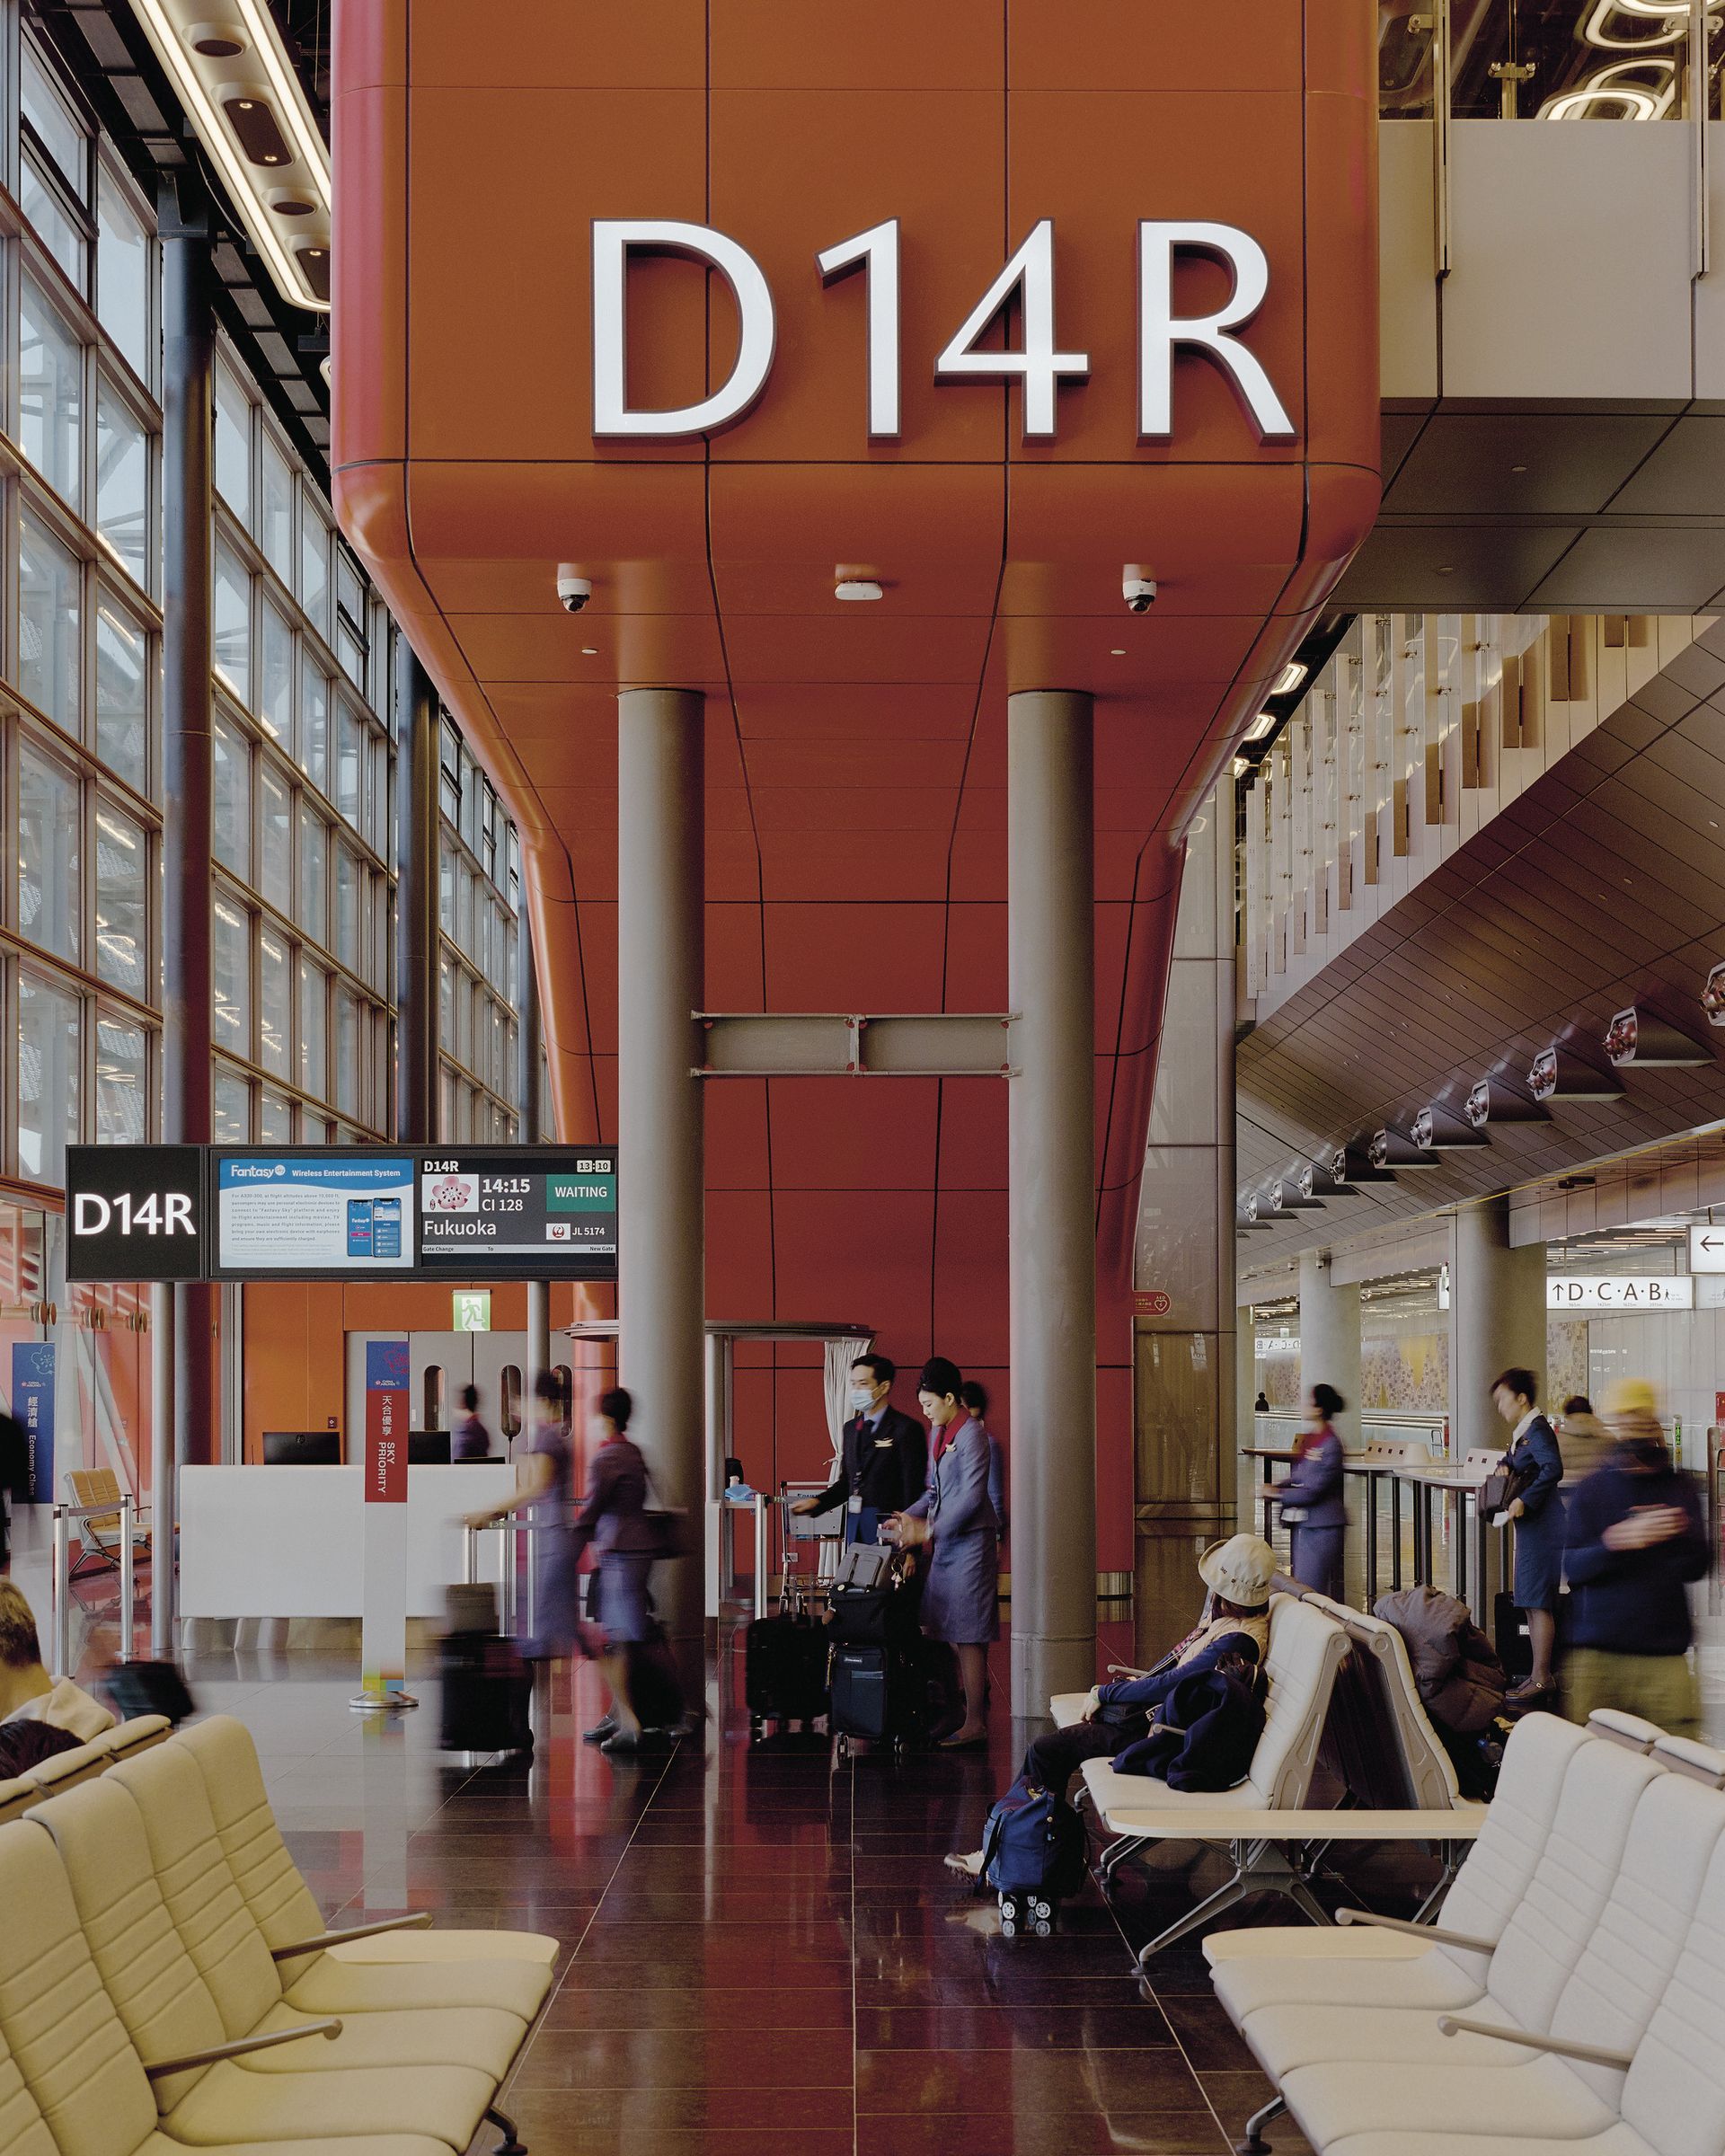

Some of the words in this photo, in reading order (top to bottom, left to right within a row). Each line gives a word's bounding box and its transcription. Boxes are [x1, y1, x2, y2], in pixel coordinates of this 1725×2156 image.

[591, 217, 1299, 439] D14R
[231, 1164, 275, 1179] Fantasy
[375, 1170, 401, 1178] System
[423, 1161, 459, 1172] D14R
[579, 1162, 608, 1171] 13:10
[482, 1179, 530, 1193] 14:15
[554, 1186, 607, 1197] WAITING
[482, 1199, 494, 1211] CI
[499, 1199, 523, 1211] 128
[75, 1193, 197, 1235] D14R
[424, 1219, 497, 1236] Fukuoka
[571, 1227, 582, 1236] JL
[584, 1227, 605, 1235] 5174
[27, 1396, 39, 1428] 經濟艙
[382, 1395, 393, 1436] 天合優享
[27, 1435, 37, 1472] Economy
[386, 1442, 395, 1465] SKY
[377, 1442, 387, 1493] PRIORITY
[29, 1473, 37, 1496] Class
